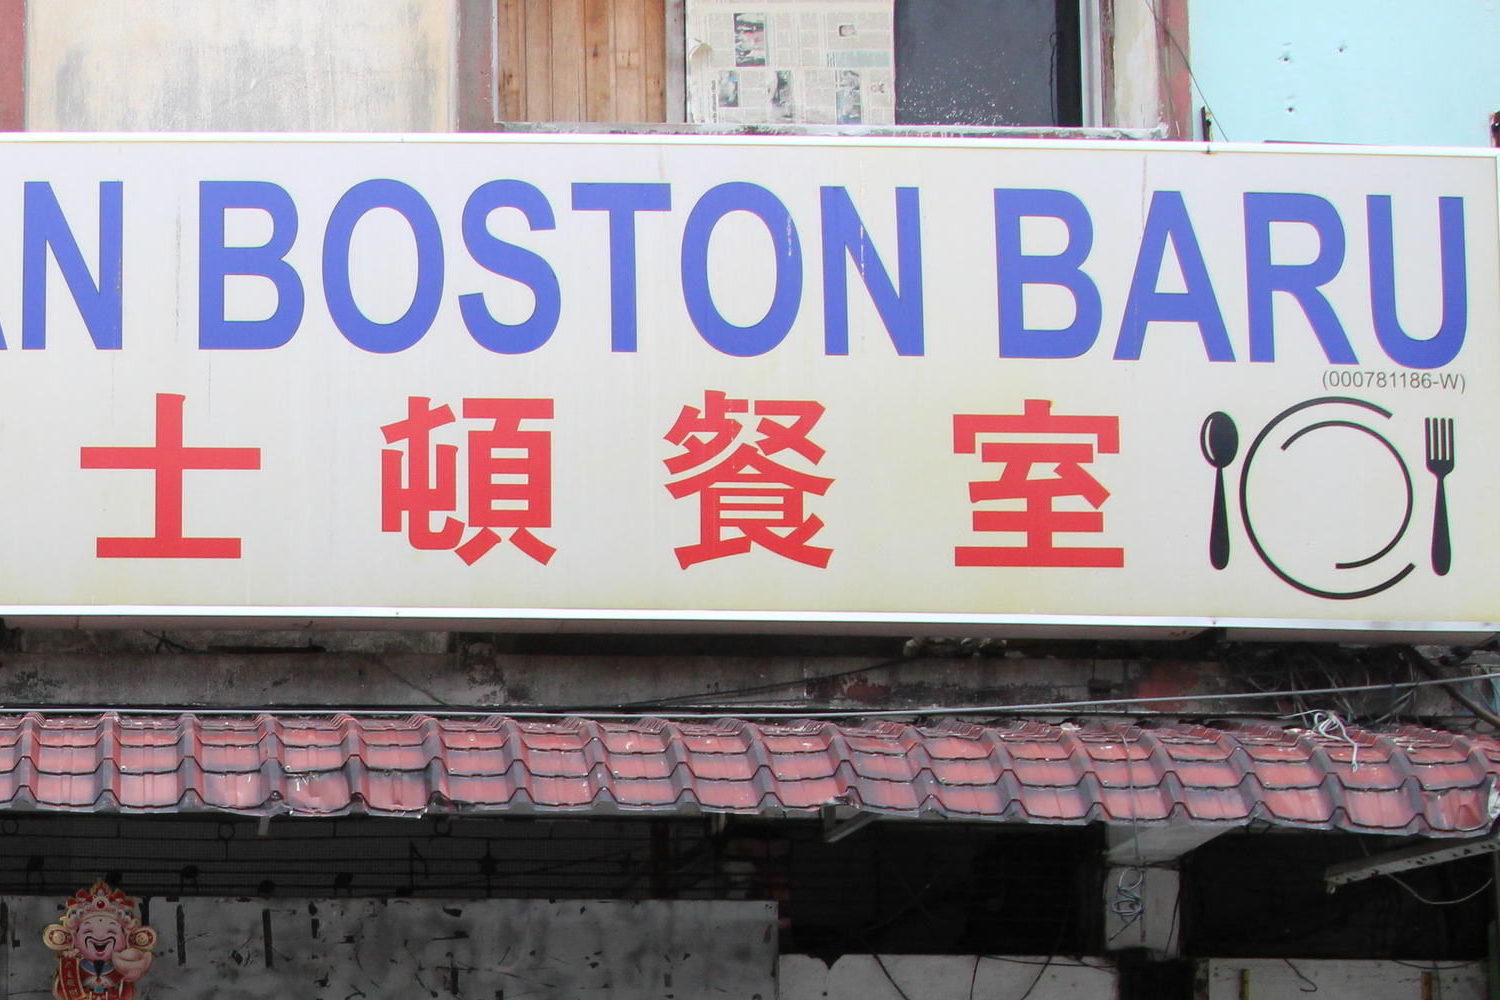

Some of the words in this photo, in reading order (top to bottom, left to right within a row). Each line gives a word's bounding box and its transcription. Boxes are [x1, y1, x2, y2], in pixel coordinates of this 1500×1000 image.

[198, 177, 925, 358] BOSTON
[993, 187, 1468, 371] BARU
[1322, 370, 1467, 395] (000781186-W)
